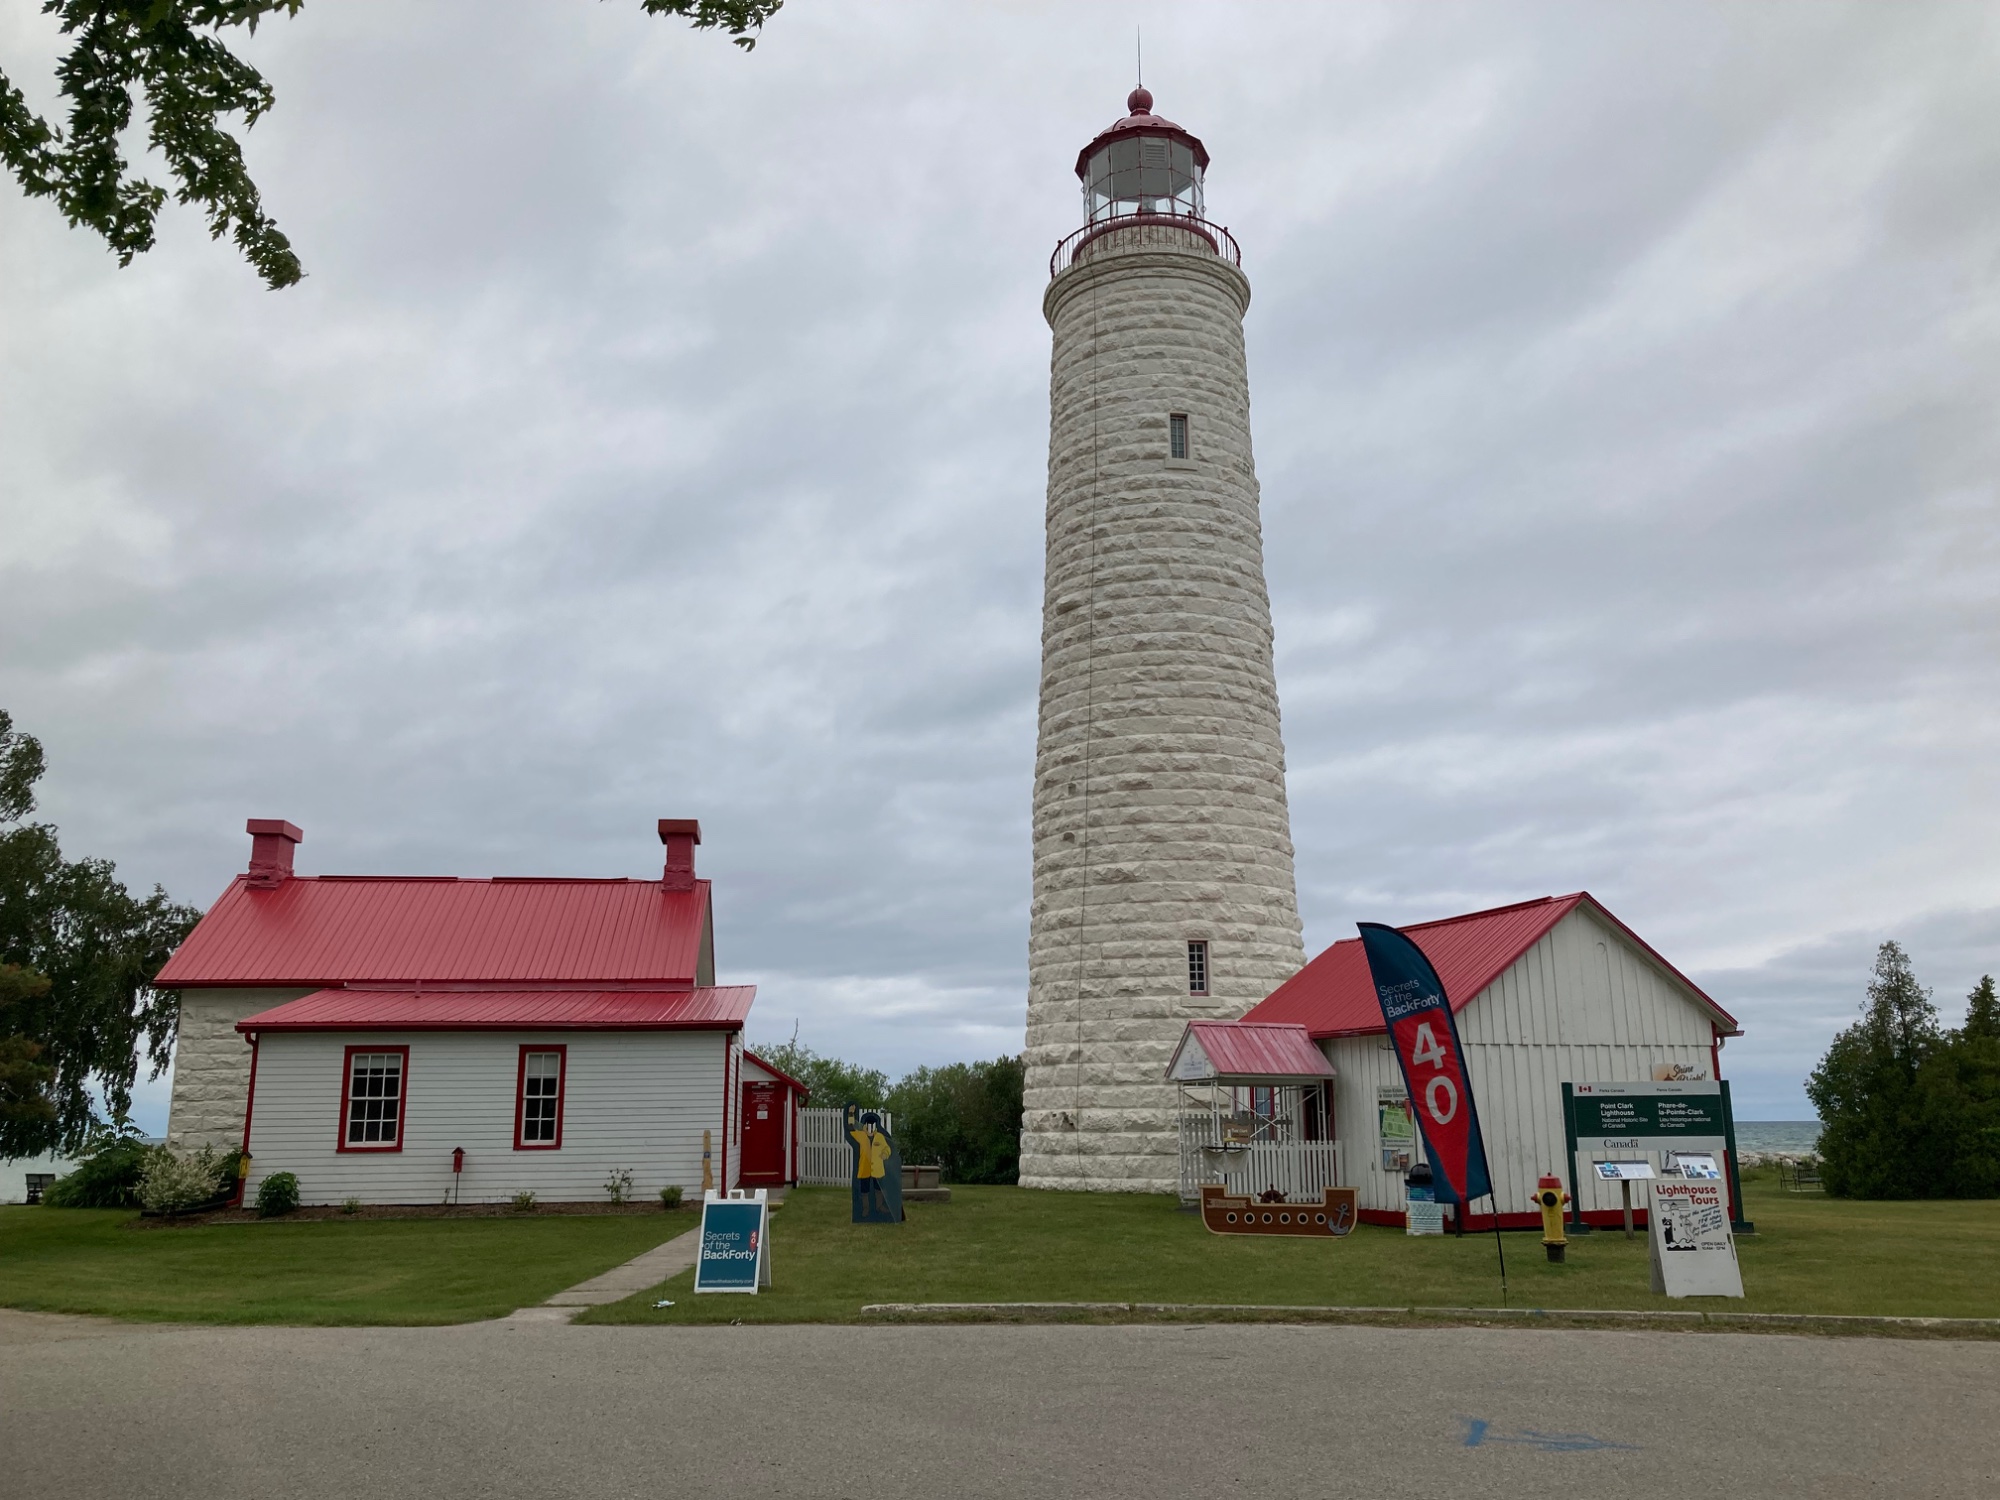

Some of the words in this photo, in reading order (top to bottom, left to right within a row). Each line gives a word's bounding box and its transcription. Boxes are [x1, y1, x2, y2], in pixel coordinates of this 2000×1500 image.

[1380, 980, 1420, 996] Secrets
[1384, 995, 1393, 1007] of
[1394, 992, 1413, 1004] the
[1386, 994, 1440, 1018] BackForty
[1600, 1109, 1634, 1117] Lighthouse
[1603, 1138, 1639, 1149] Canada
[1656, 1184, 1717, 1197] Lighthouse
[1689, 1194, 1720, 1205] Tours
[705, 1231, 740, 1241] Secrets
[704, 1241, 714, 1250] of
[716, 1241, 730, 1250] the
[703, 1250, 755, 1261] BackForty
